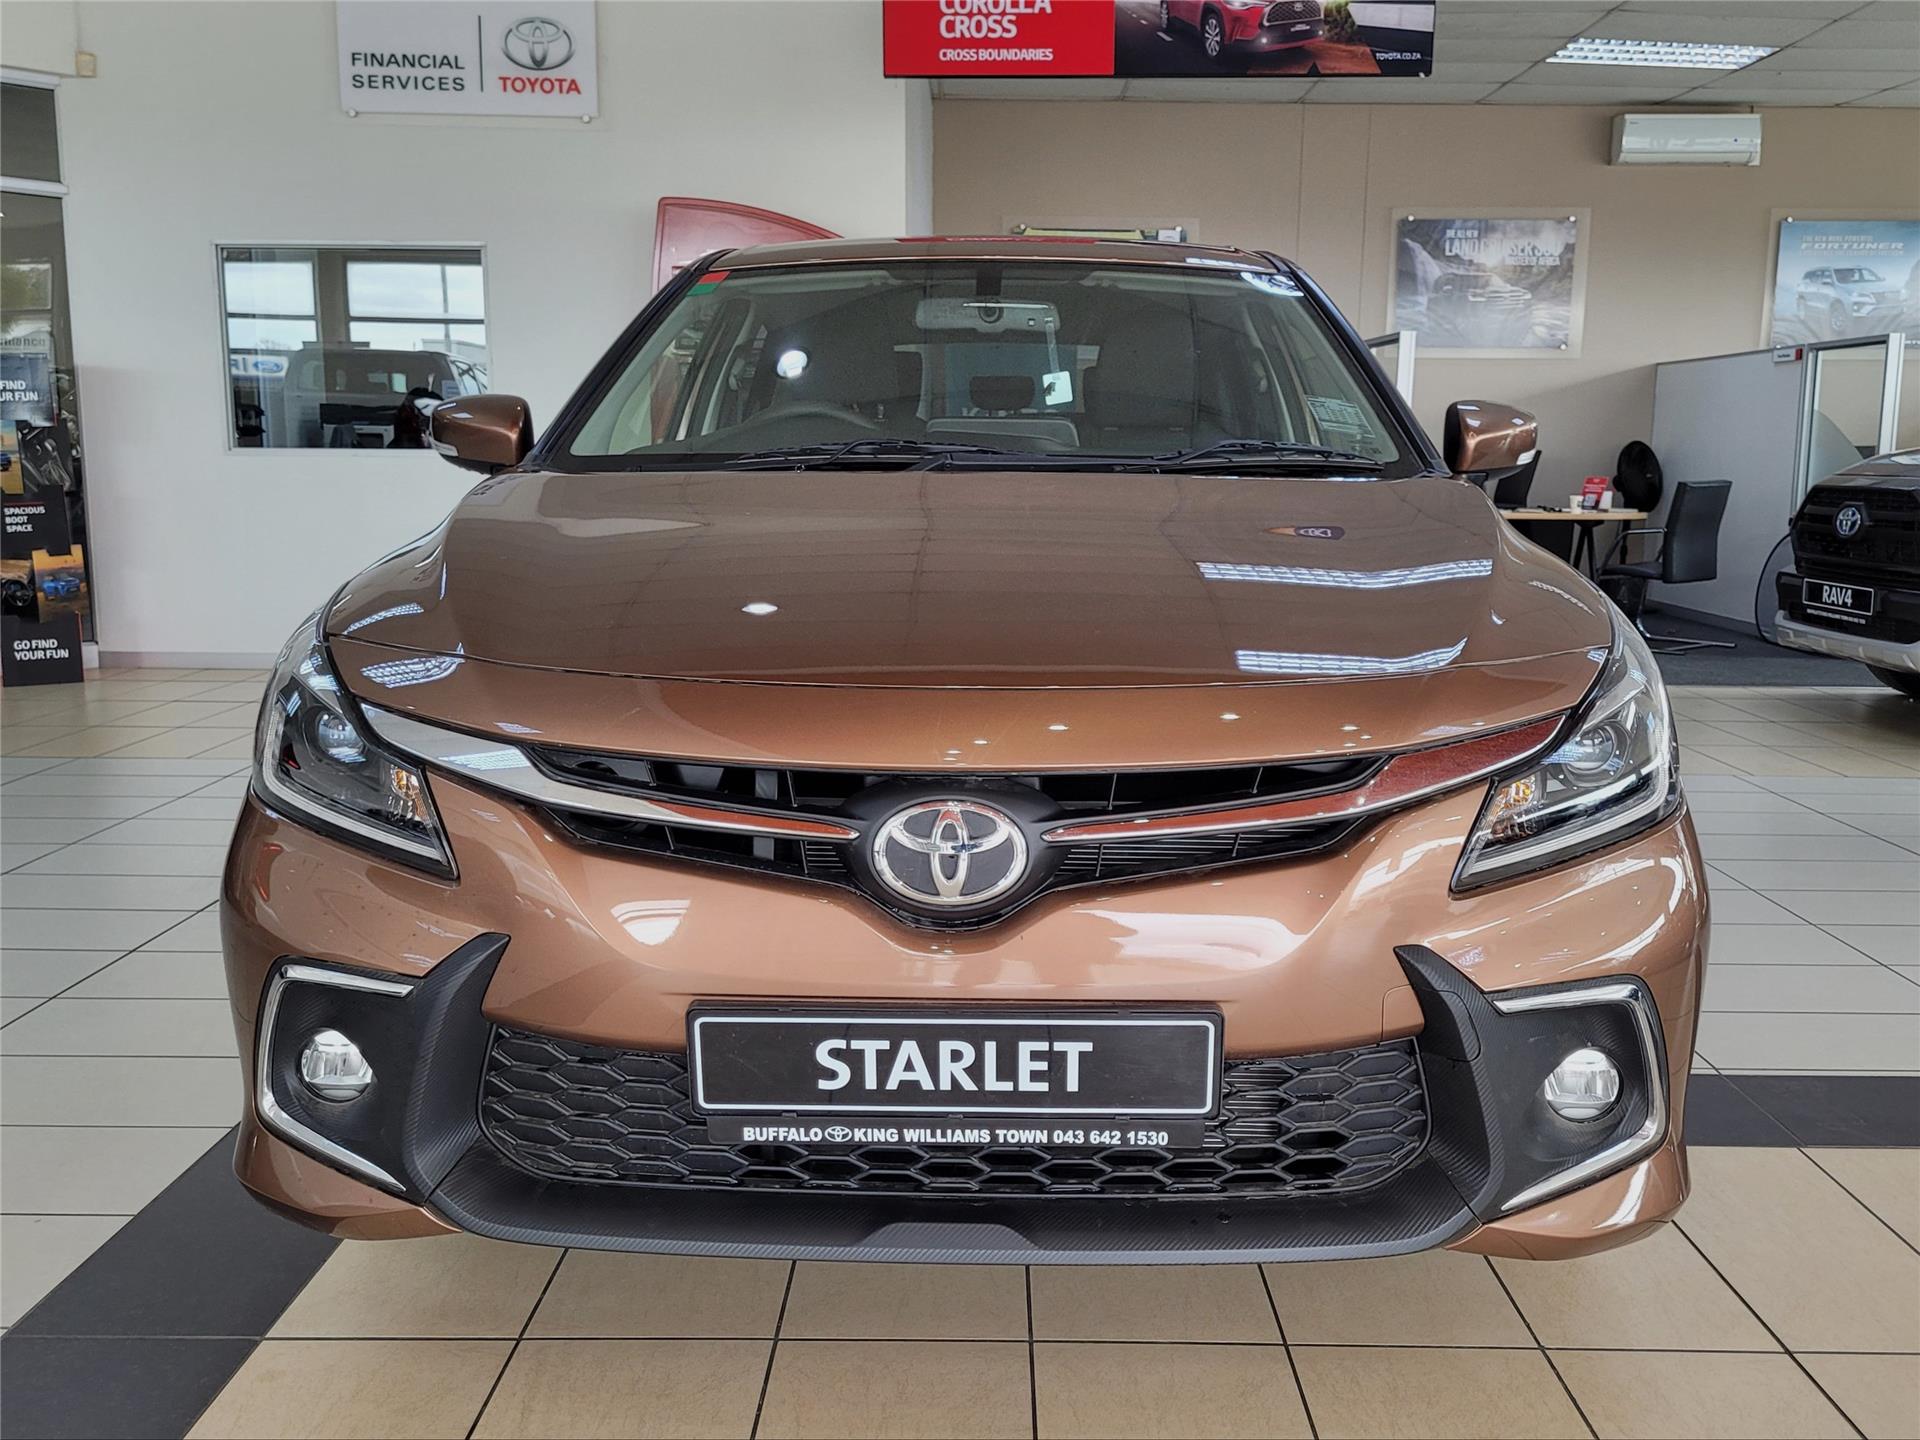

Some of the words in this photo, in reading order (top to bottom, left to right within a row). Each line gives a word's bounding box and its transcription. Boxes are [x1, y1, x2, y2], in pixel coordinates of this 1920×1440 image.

[939, 0, 1053, 14] COROLLA
[939, 15, 1018, 39] CROSS
[351, 52, 465, 70] FINANCIAL
[939, 48, 978, 61] CROSS
[978, 48, 1054, 61] BOUNDARIES
[1375, 52, 1422, 61] TOYOTA.CO.ZA
[352, 74, 465, 92] SERVICES
[498, 76, 582, 96] TOYOTA
[1445, 239, 1478, 257] LAND
[1800, 242, 1904, 250] FORTUNER
[0, 380, 26, 390] FIND
[15, 391, 39, 402] FUN
[4, 506, 46, 515] SPACIOUS
[5, 515, 28, 524] BOOT
[6, 524, 33, 533] SPACE
[1822, 585, 1853, 607] RAV4
[13, 640, 31, 650] GO
[31, 638, 58, 649] FIND
[14, 650, 45, 661] YOUR
[46, 648, 70, 659] FUN
[815, 1038, 1094, 1092] STARLET
[743, 1127, 823, 1142] BUFFALO
[854, 1128, 899, 1143] KING
[903, 1128, 991, 1143] WILLIAMS
[996, 1129, 1048, 1144] TOWN
[1053, 1129, 1085, 1144] 043
[1090, 1130, 1121, 1145] 642
[1127, 1131, 1169, 1146] 1530
